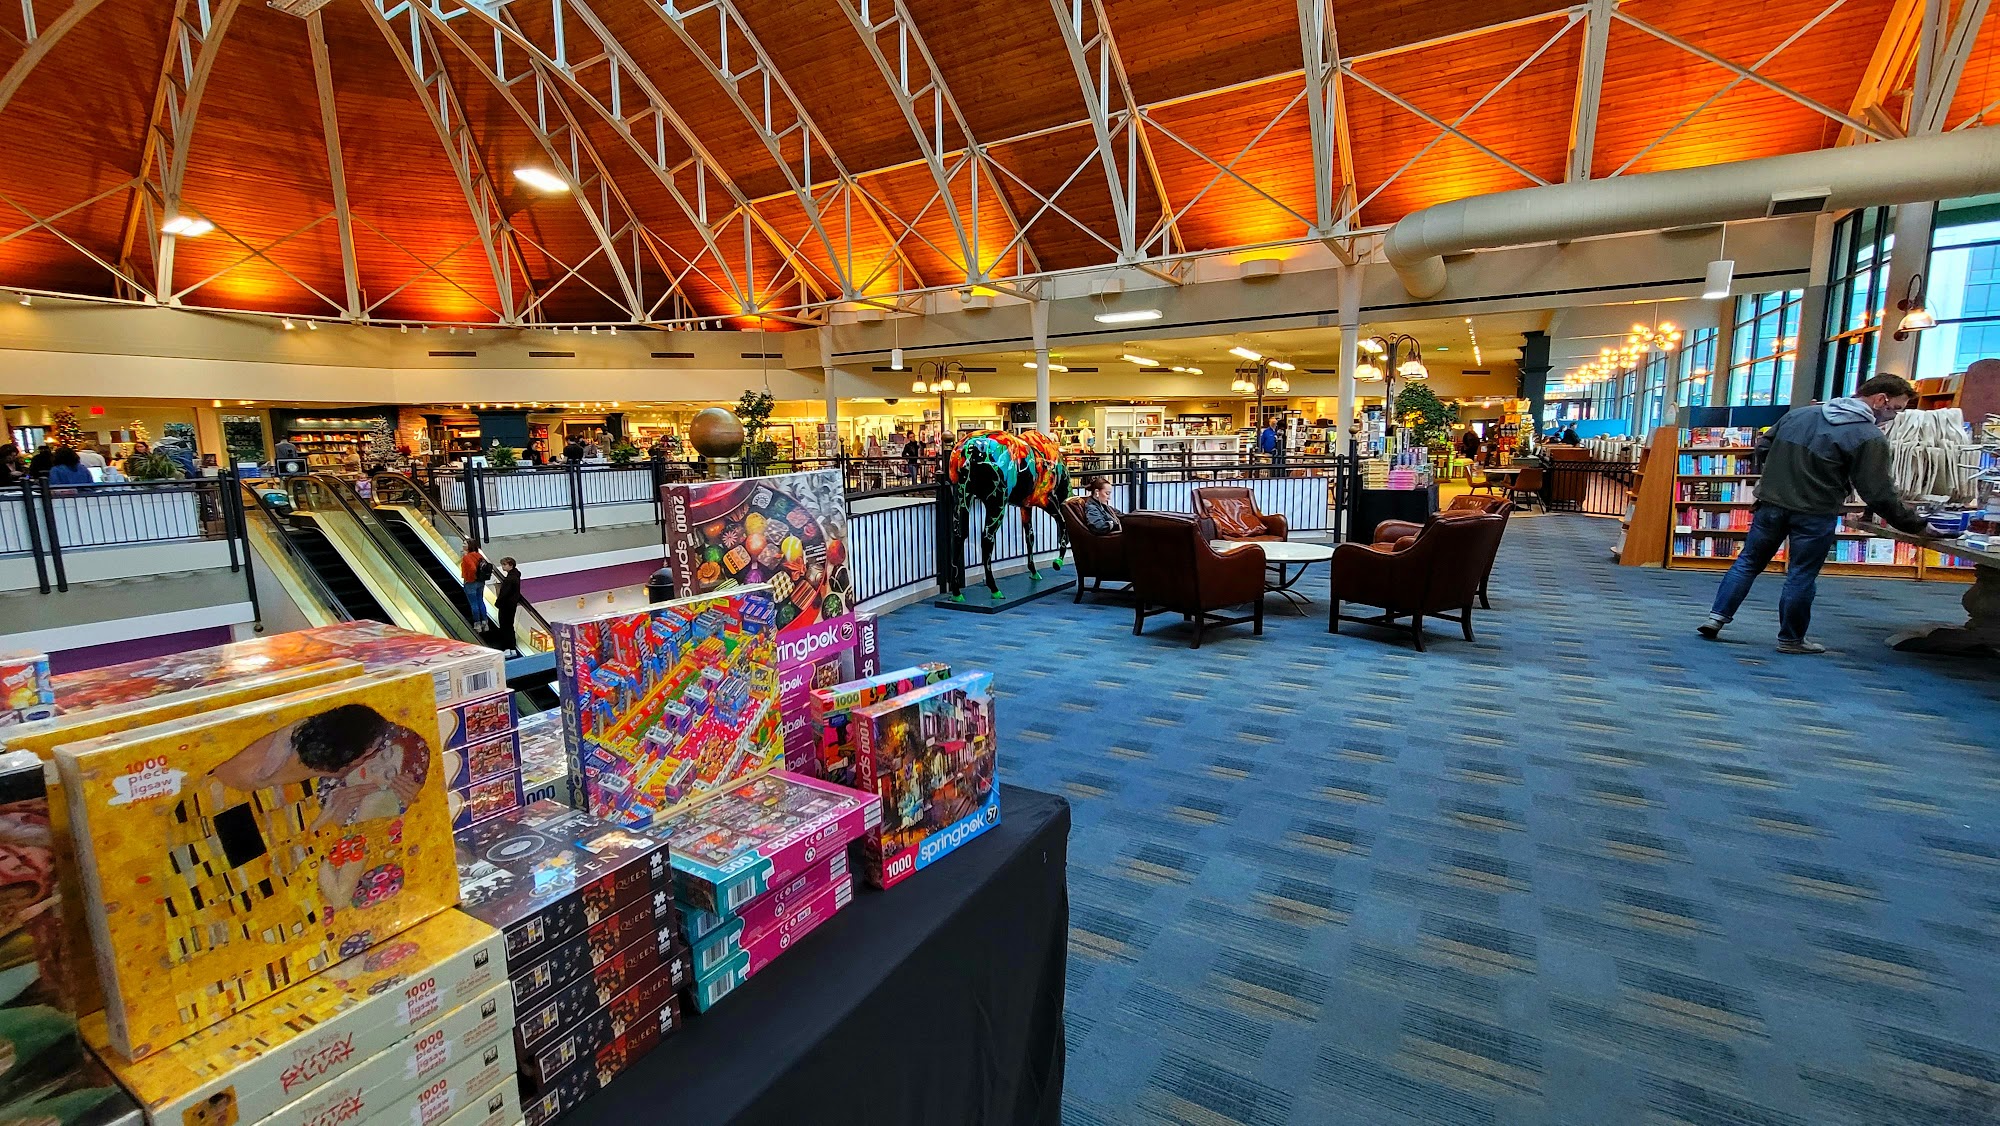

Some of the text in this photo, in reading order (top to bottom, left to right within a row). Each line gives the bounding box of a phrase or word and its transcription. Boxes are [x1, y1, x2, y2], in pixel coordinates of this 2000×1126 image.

[673, 495, 693, 598] 2000 spring
[777, 624, 839, 662] ringbok
[864, 624, 875, 654] 2000
[780, 674, 804, 697] gbok
[836, 692, 860, 707] 1000
[560, 624, 589, 812] 1500 springbo
[782, 715, 807, 738] gbok
[859, 720, 871, 755] 1000
[125, 754, 168, 774] 1000
[128, 767, 170, 787] piece
[129, 778, 173, 798] jigsaw
[126, 788, 174, 810] puzzle
[526, 785, 556, 806] 000
[766, 810, 840, 850] springbok
[920, 812, 985, 863] springbok
[529, 852, 620, 898] QUEEN
[719, 855, 756, 874] 500
[886, 854, 912, 878] 1000
[615, 867, 649, 890] QUEEN
[620, 907, 652, 931] QUEEN
[625, 943, 656, 969] QUEEN
[405, 977, 435, 999] 1000
[408, 988, 437, 1008] piece
[639, 976, 669, 1001] QUEEN
[409, 996, 439, 1018] jigsaw
[410, 1005, 439, 1026] puzzle
[413, 1029, 444, 1052] 1000
[627, 1023, 657, 1050] QUEEN
[416, 1040, 445, 1061] piece
[417, 1048, 447, 1072] jigsaw
[418, 1056, 447, 1079] puzzle
[417, 1079, 447, 1103] 1000
[420, 1089, 448, 1110] piece
[421, 1097, 450, 1121] jigsaw
